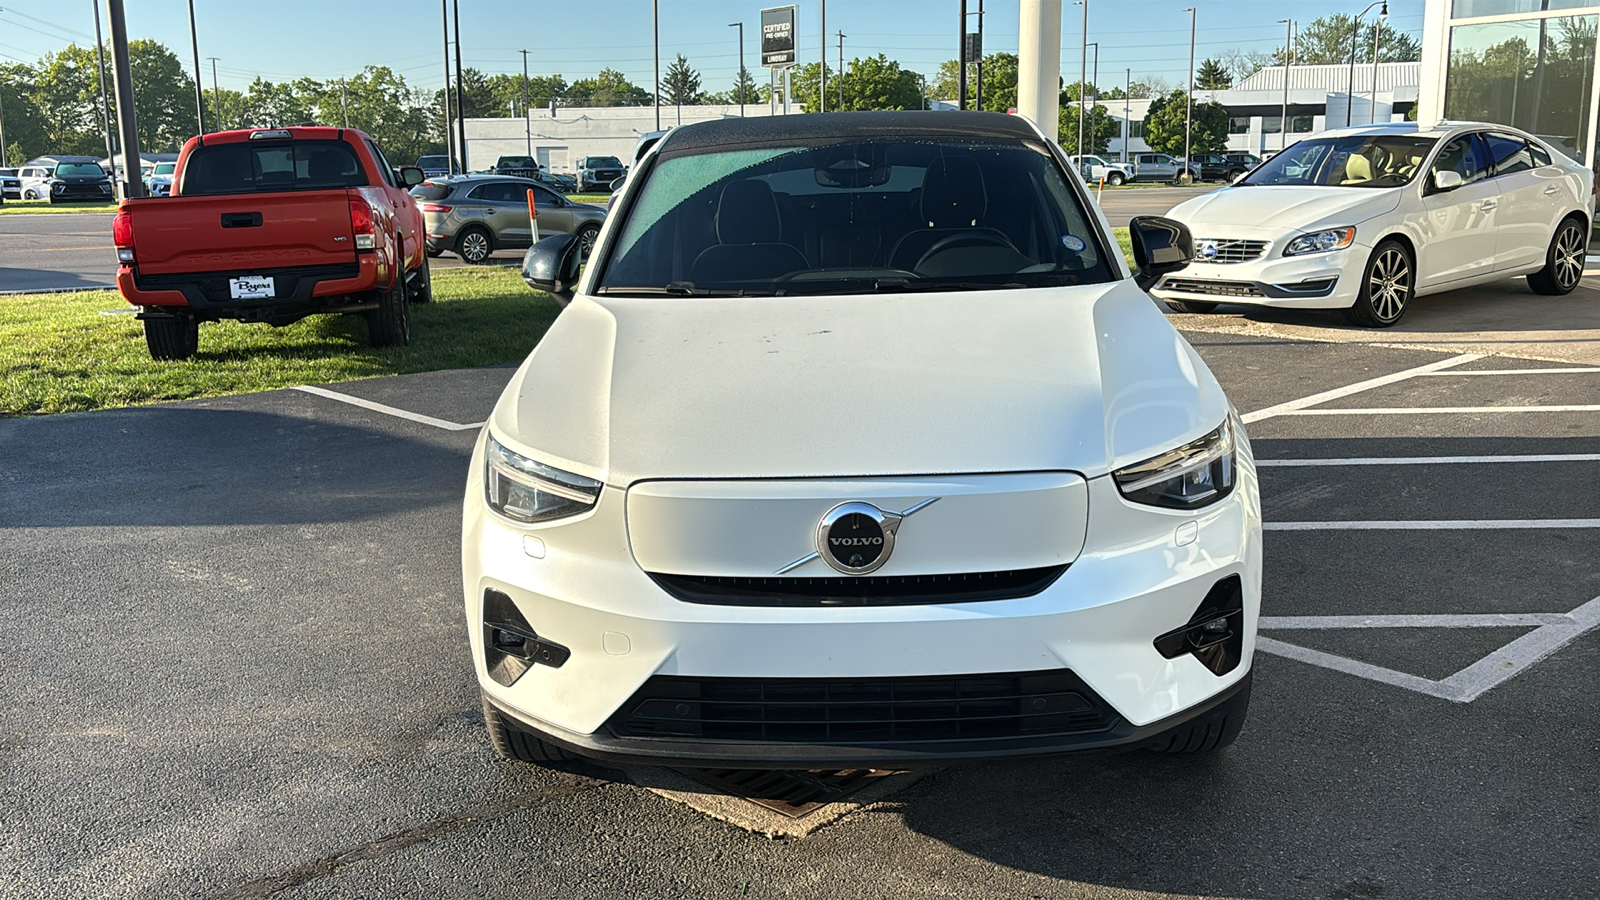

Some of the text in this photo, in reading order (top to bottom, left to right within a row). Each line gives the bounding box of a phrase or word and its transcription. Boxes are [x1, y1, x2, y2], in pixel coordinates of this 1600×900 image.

[763, 23, 790, 32] CERTIFIED
[767, 55, 787, 63] LINDSAY
[186, 250, 311, 262] TACOMA
[233, 281, 271, 292] Byers
[829, 537, 882, 545] VOLVO
